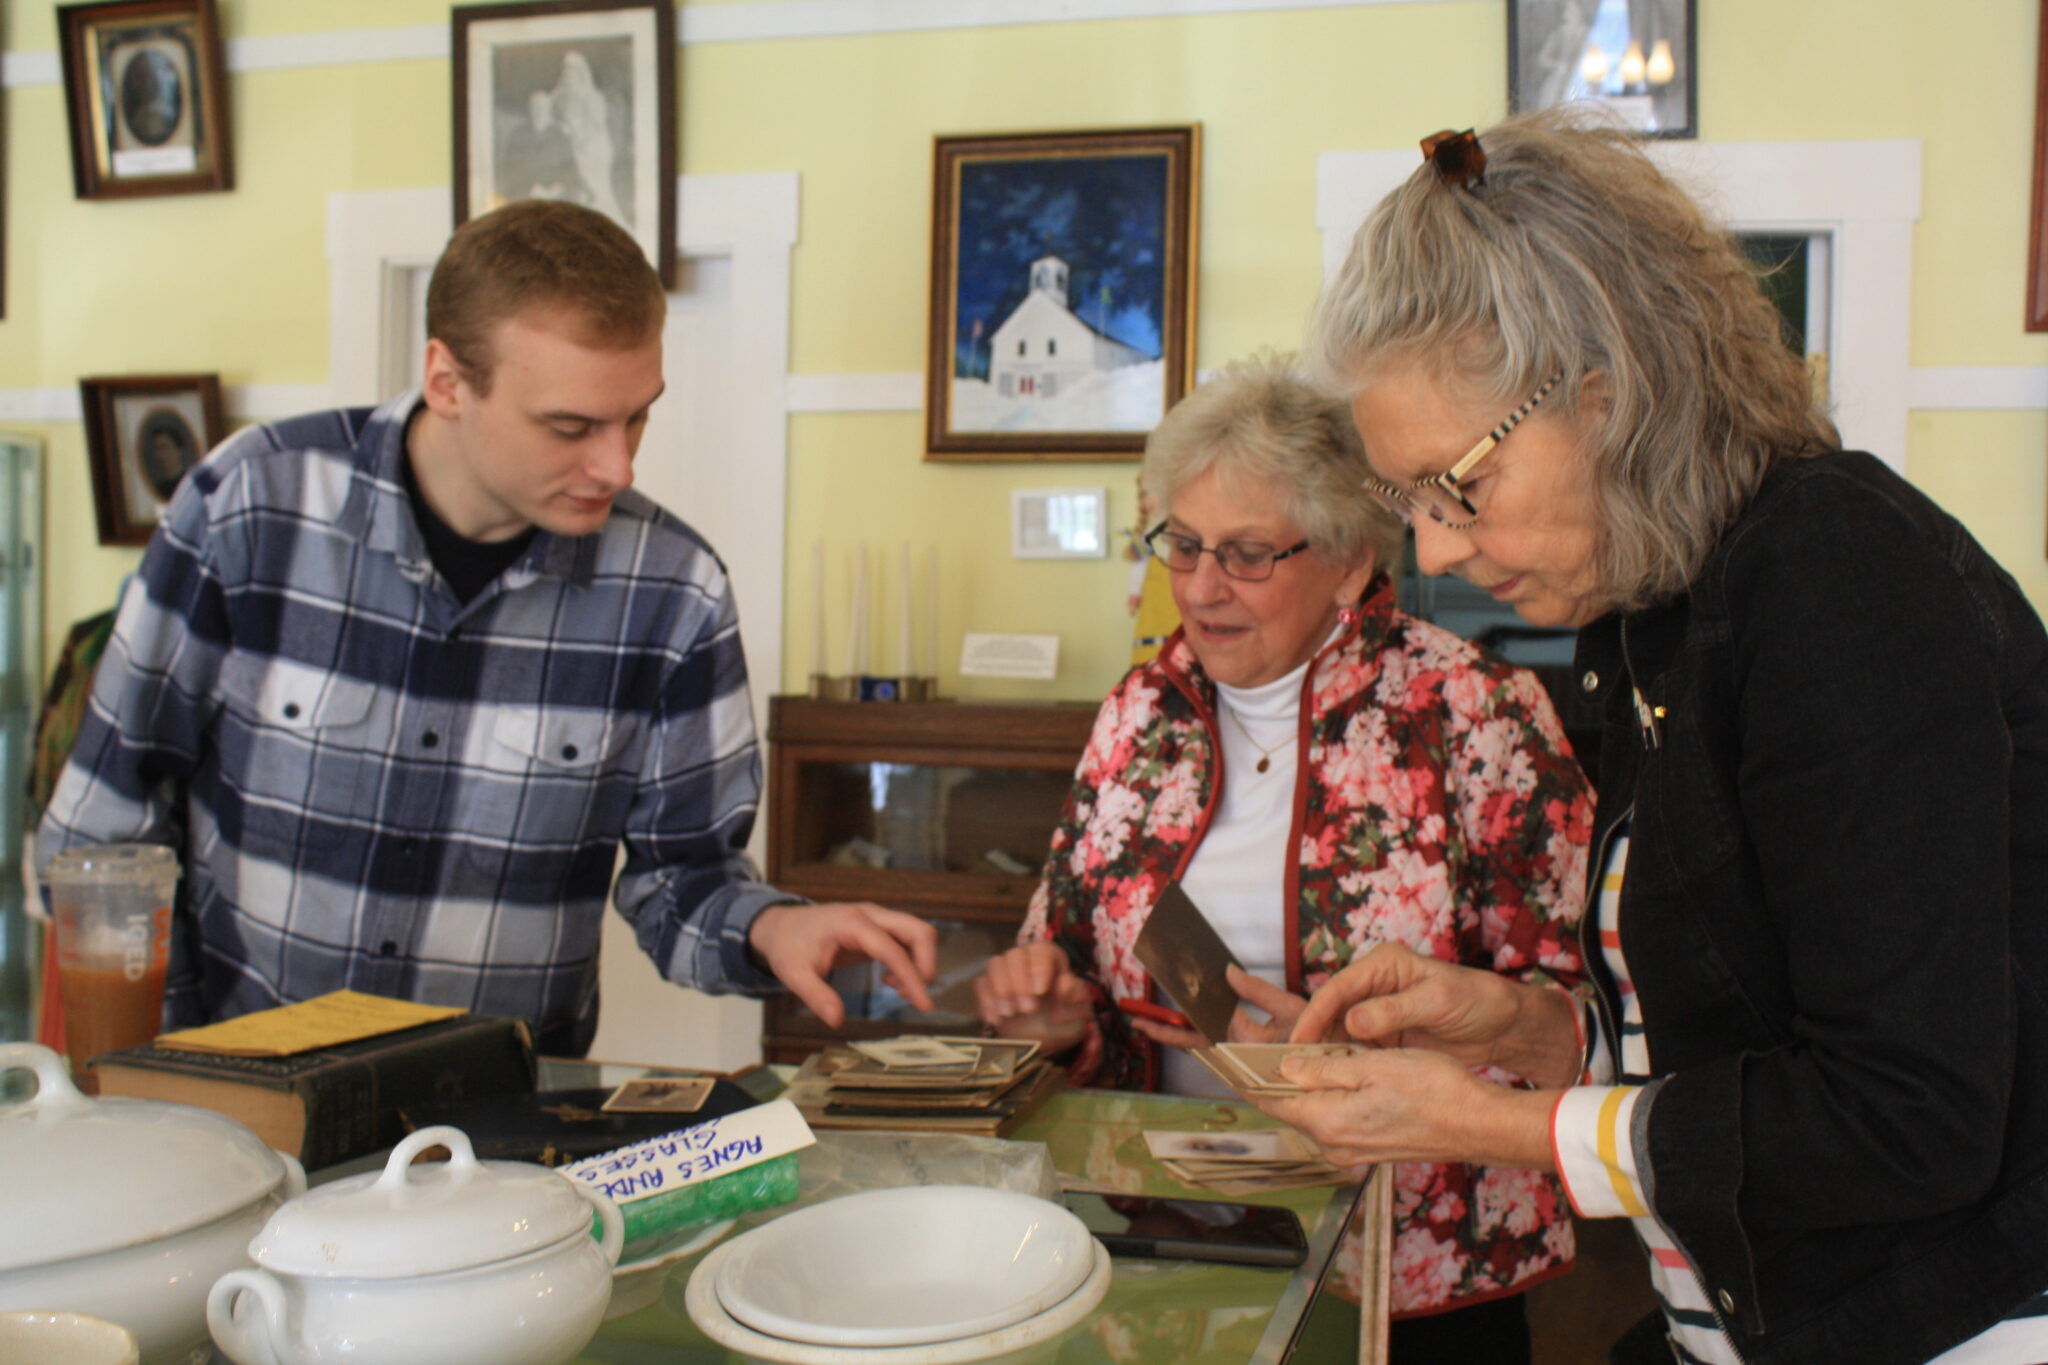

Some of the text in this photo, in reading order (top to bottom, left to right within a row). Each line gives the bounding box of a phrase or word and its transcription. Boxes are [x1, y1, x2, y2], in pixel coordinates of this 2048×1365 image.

[124, 913, 149, 982] ICED
[576, 1131, 717, 1183] GLASSES
[677, 1134, 763, 1179] AGNES
